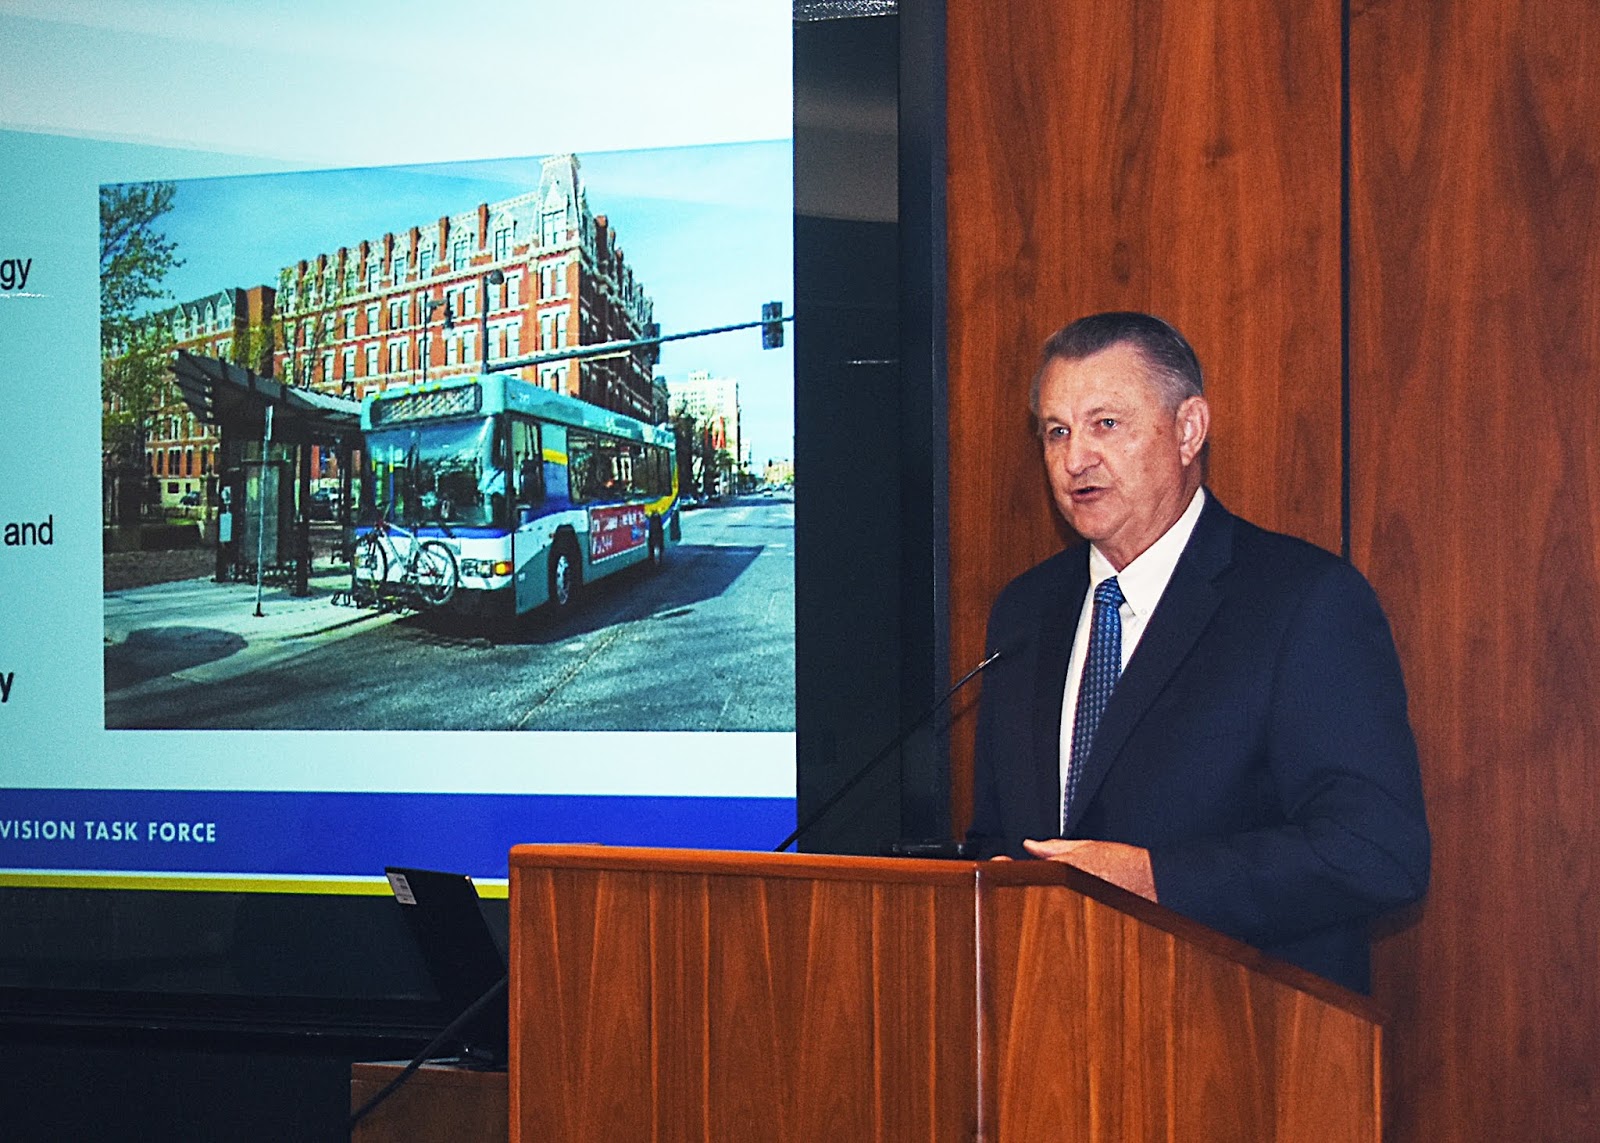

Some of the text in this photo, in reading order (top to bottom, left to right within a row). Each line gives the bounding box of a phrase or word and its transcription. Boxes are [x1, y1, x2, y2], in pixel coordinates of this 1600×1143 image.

[0, 258, 32, 290] gy
[4, 514, 53, 546] and
[0, 672, 14, 703] y
[0, 820, 216, 842] VISION TASK FORCE
